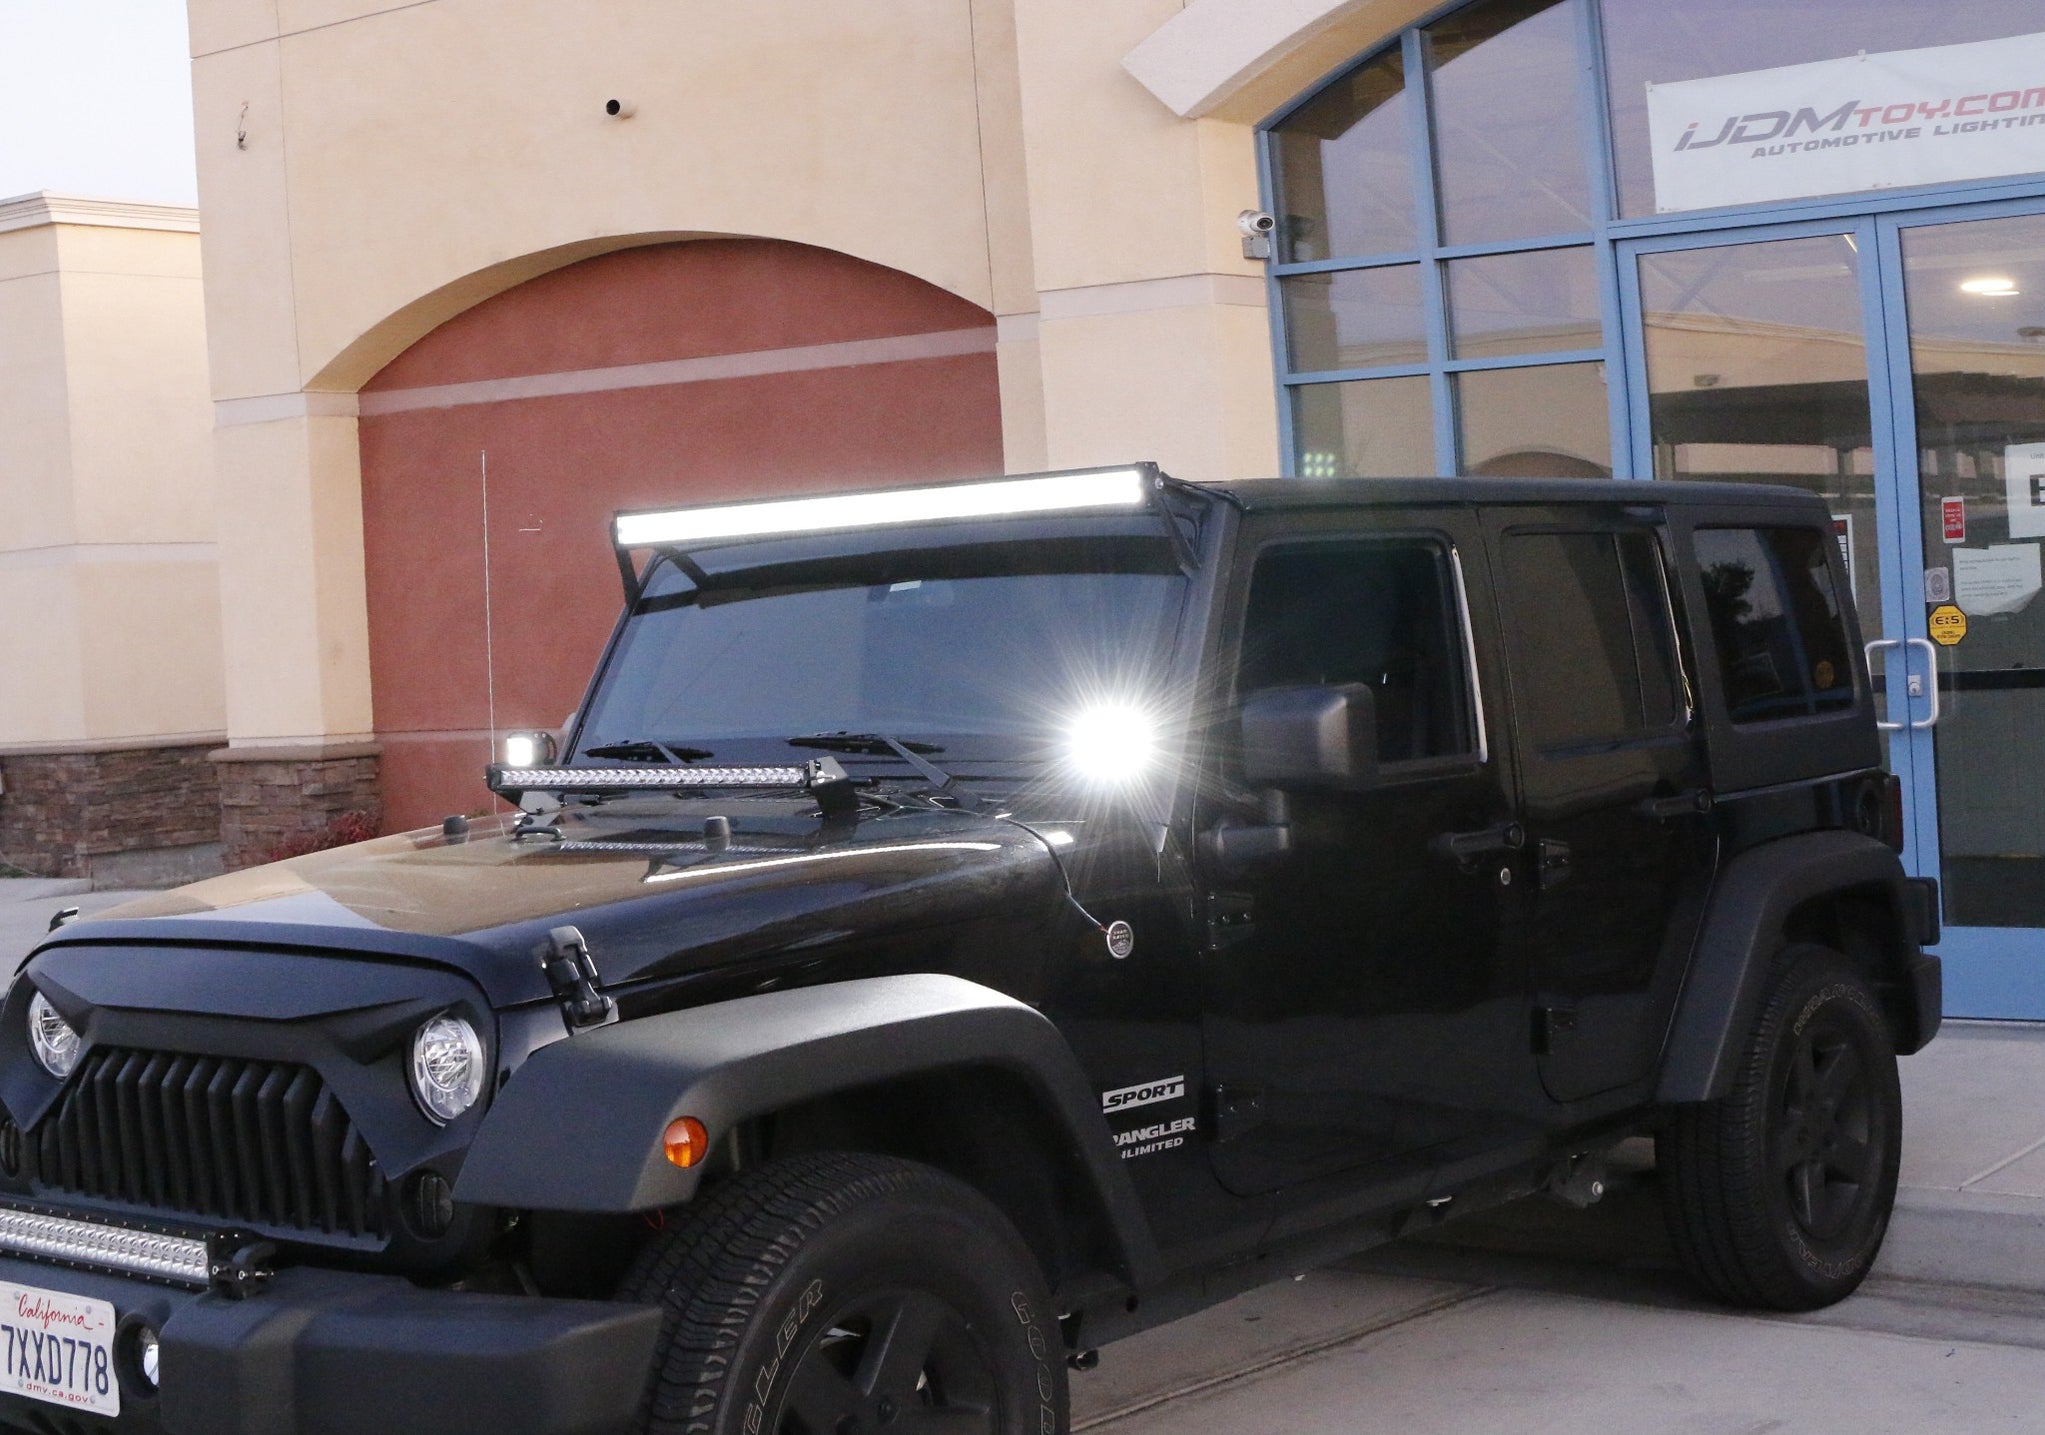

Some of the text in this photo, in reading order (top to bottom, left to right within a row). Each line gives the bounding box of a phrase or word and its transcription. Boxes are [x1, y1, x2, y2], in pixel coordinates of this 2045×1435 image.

[1751, 127, 1921, 159] AUTOMOTIVE
[1104, 1081, 1184, 1109] SPORT
[18, 1293, 94, 1330] California
[1, 1324, 109, 1396] 7XXD778
[26, 1382, 90, 1404] dmv.ca.gov
